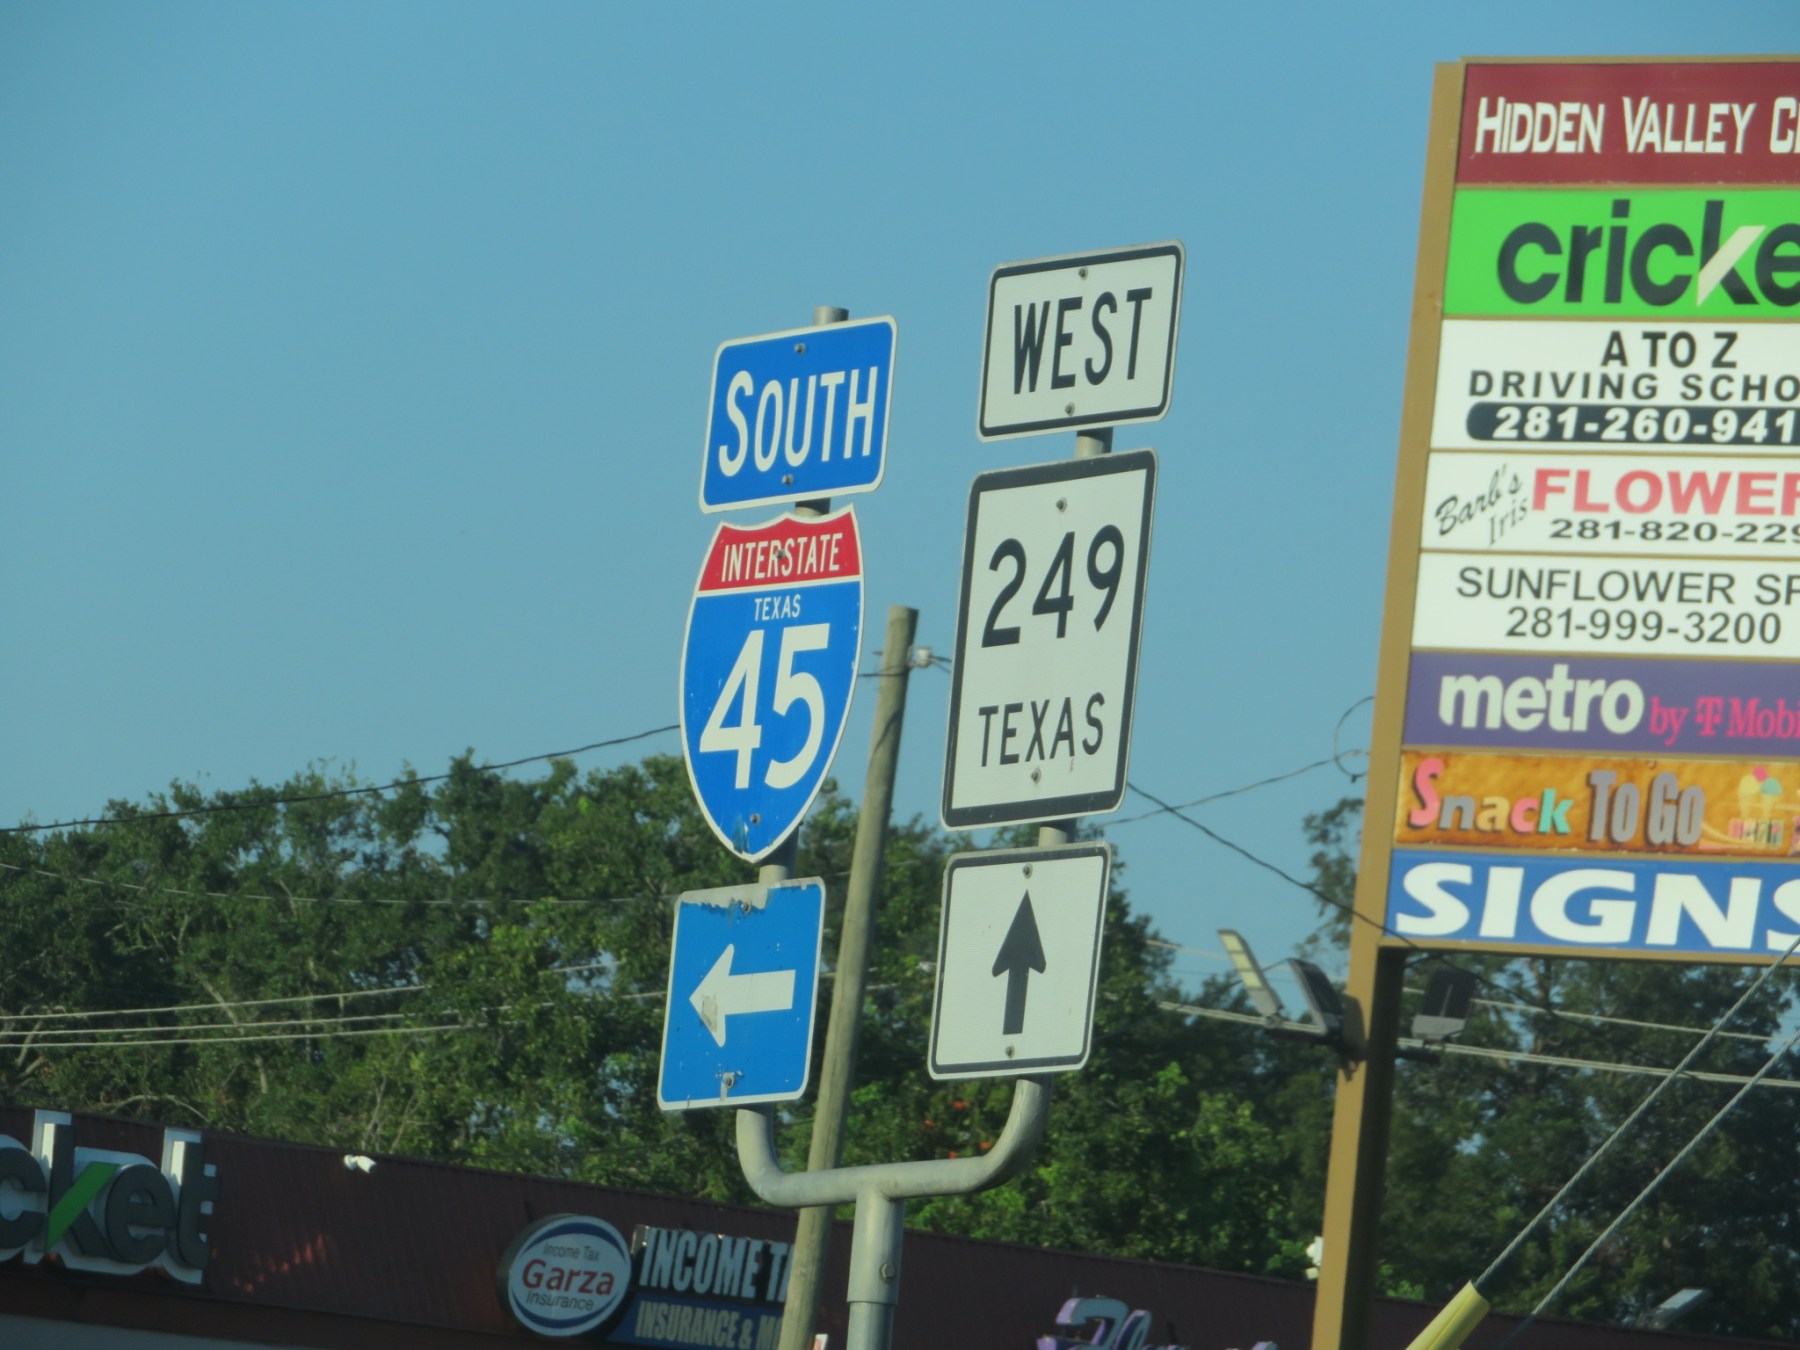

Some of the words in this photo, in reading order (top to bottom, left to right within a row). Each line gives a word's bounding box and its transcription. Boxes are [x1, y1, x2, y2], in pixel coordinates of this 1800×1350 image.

[1475, 96, 1605, 154] HIDDEN
[1622, 95, 1756, 154] VALLEY
[1769, 96, 1800, 154] C
[1014, 287, 1153, 395] WEST
[1600, 331, 1628, 367] A
[1642, 331, 1697, 368] TO
[1711, 331, 1738, 368] Z
[1469, 370, 1659, 401] DRIVING
[1680, 373, 1800, 402] SCHO
[719, 366, 878, 477] SOUTH
[1493, 406, 1796, 444] 281-260-941
[1435, 462, 1522, 536] Barb's
[721, 532, 843, 583] INTERSTATE
[981, 525, 1124, 649] 249
[1456, 567, 1736, 605] SUNFLOWER
[754, 594, 801, 621] TEXAS
[1505, 607, 1782, 645] 281-999-3200
[699, 623, 830, 790] 45
[978, 692, 1105, 767] TEXAS
[1438, 664, 1645, 735] metro
[1649, 696, 1689, 747] by
[1408, 758, 1574, 834] Snack
[522, 1258, 615, 1296] Garza
[639, 1226, 765, 1299] INCOME
[634, 1300, 740, 1347] INSURANCE
[739, 1317, 754, 1350] &
